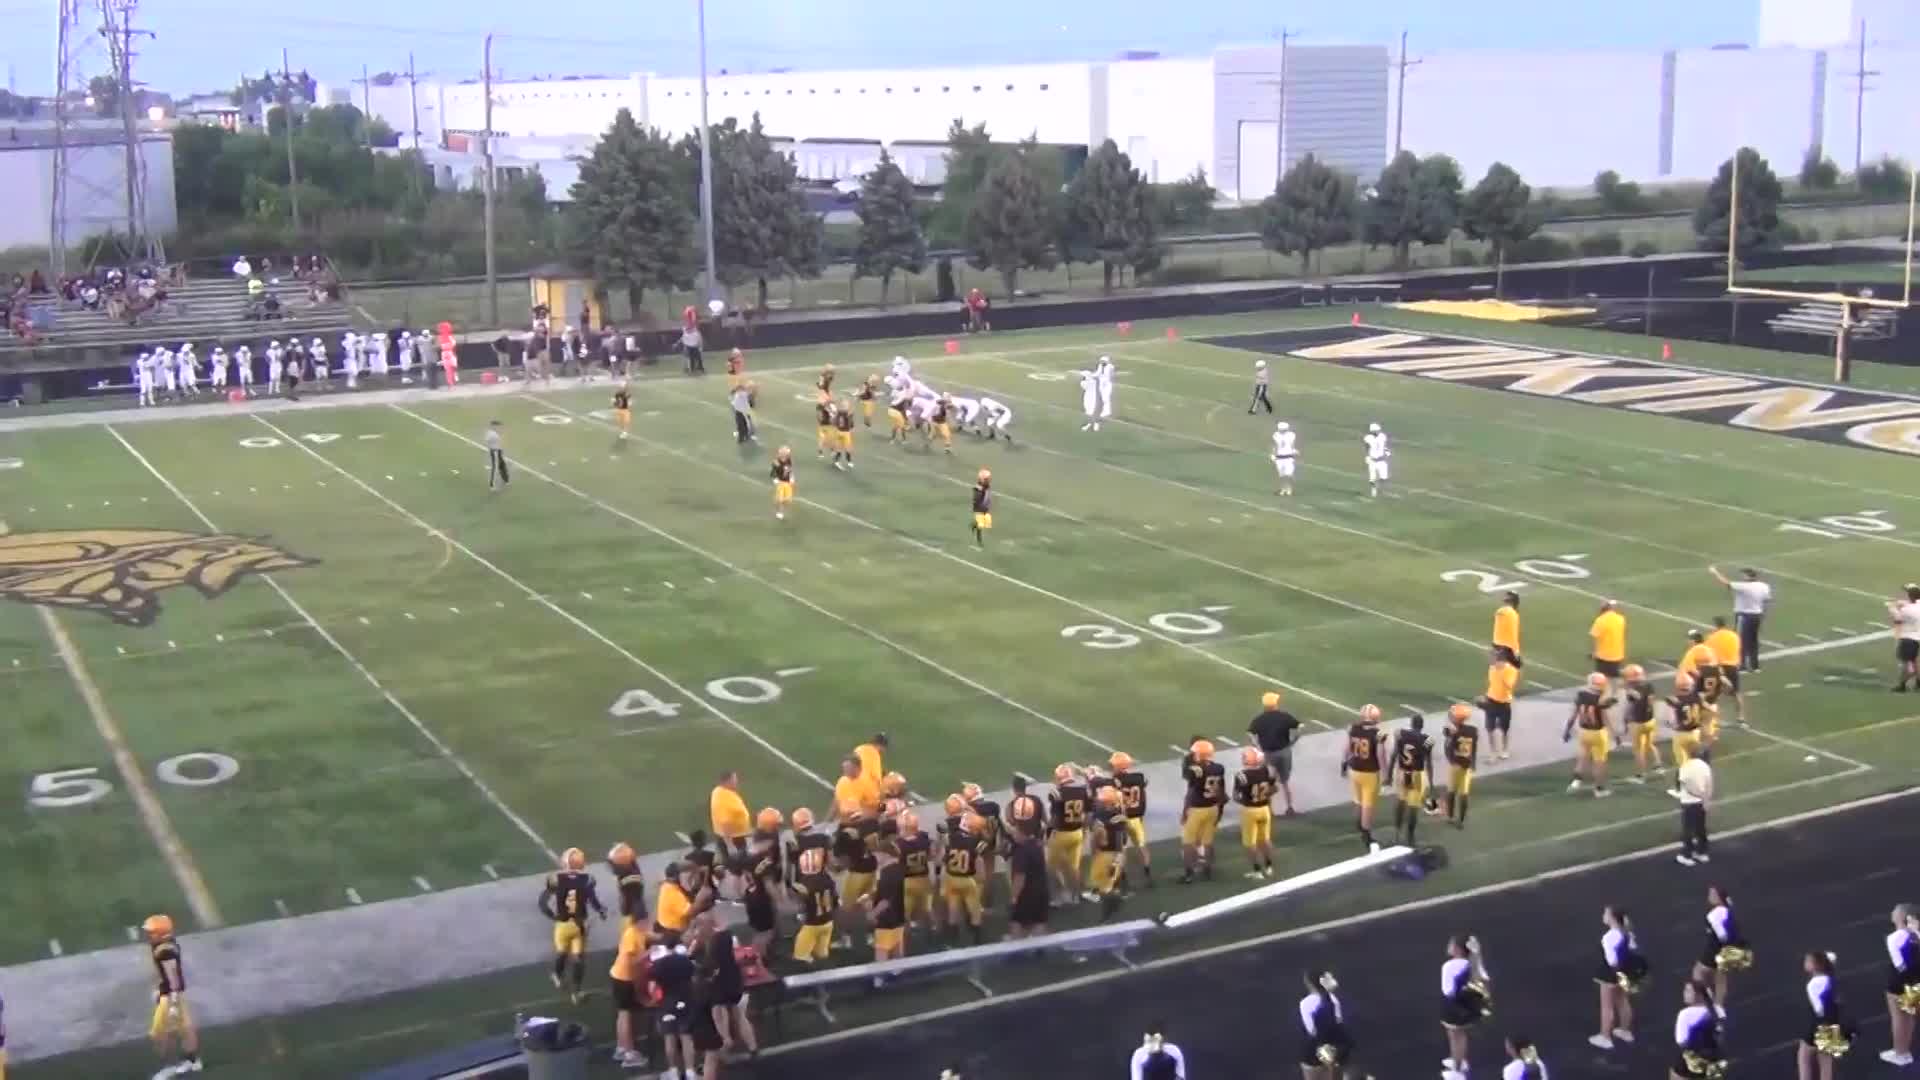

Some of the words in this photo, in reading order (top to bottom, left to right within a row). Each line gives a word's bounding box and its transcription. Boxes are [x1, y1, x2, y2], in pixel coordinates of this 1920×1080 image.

[1440, 558, 1592, 594] 20
[1060, 612, 1224, 649] 30
[608, 675, 783, 718] 40
[1402, 743, 1417, 767] 5
[30, 752, 241, 807] 50
